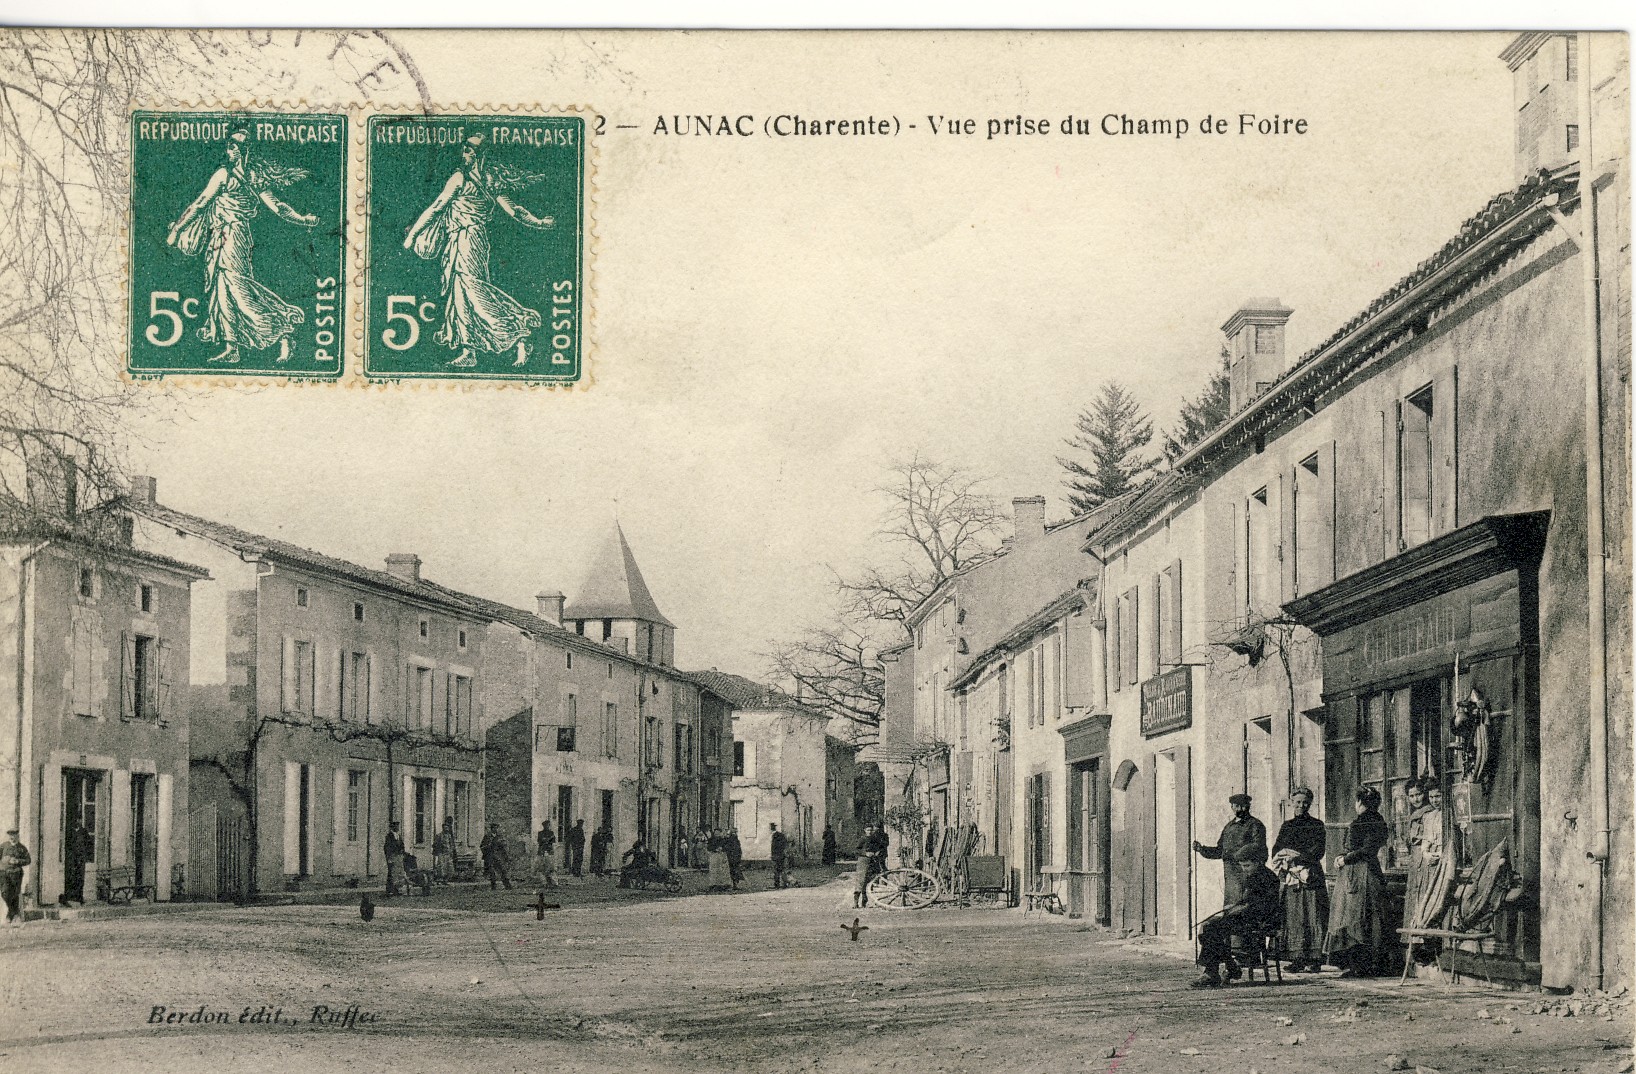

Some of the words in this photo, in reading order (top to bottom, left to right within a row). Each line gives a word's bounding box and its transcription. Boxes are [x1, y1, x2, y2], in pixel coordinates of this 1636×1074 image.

[256, 123, 339, 144] FRANÇAISE
[492, 126, 575, 147] FRANÇAISE
[315, 276, 336, 361] POSTES
[552, 280, 573, 365] POSTES
